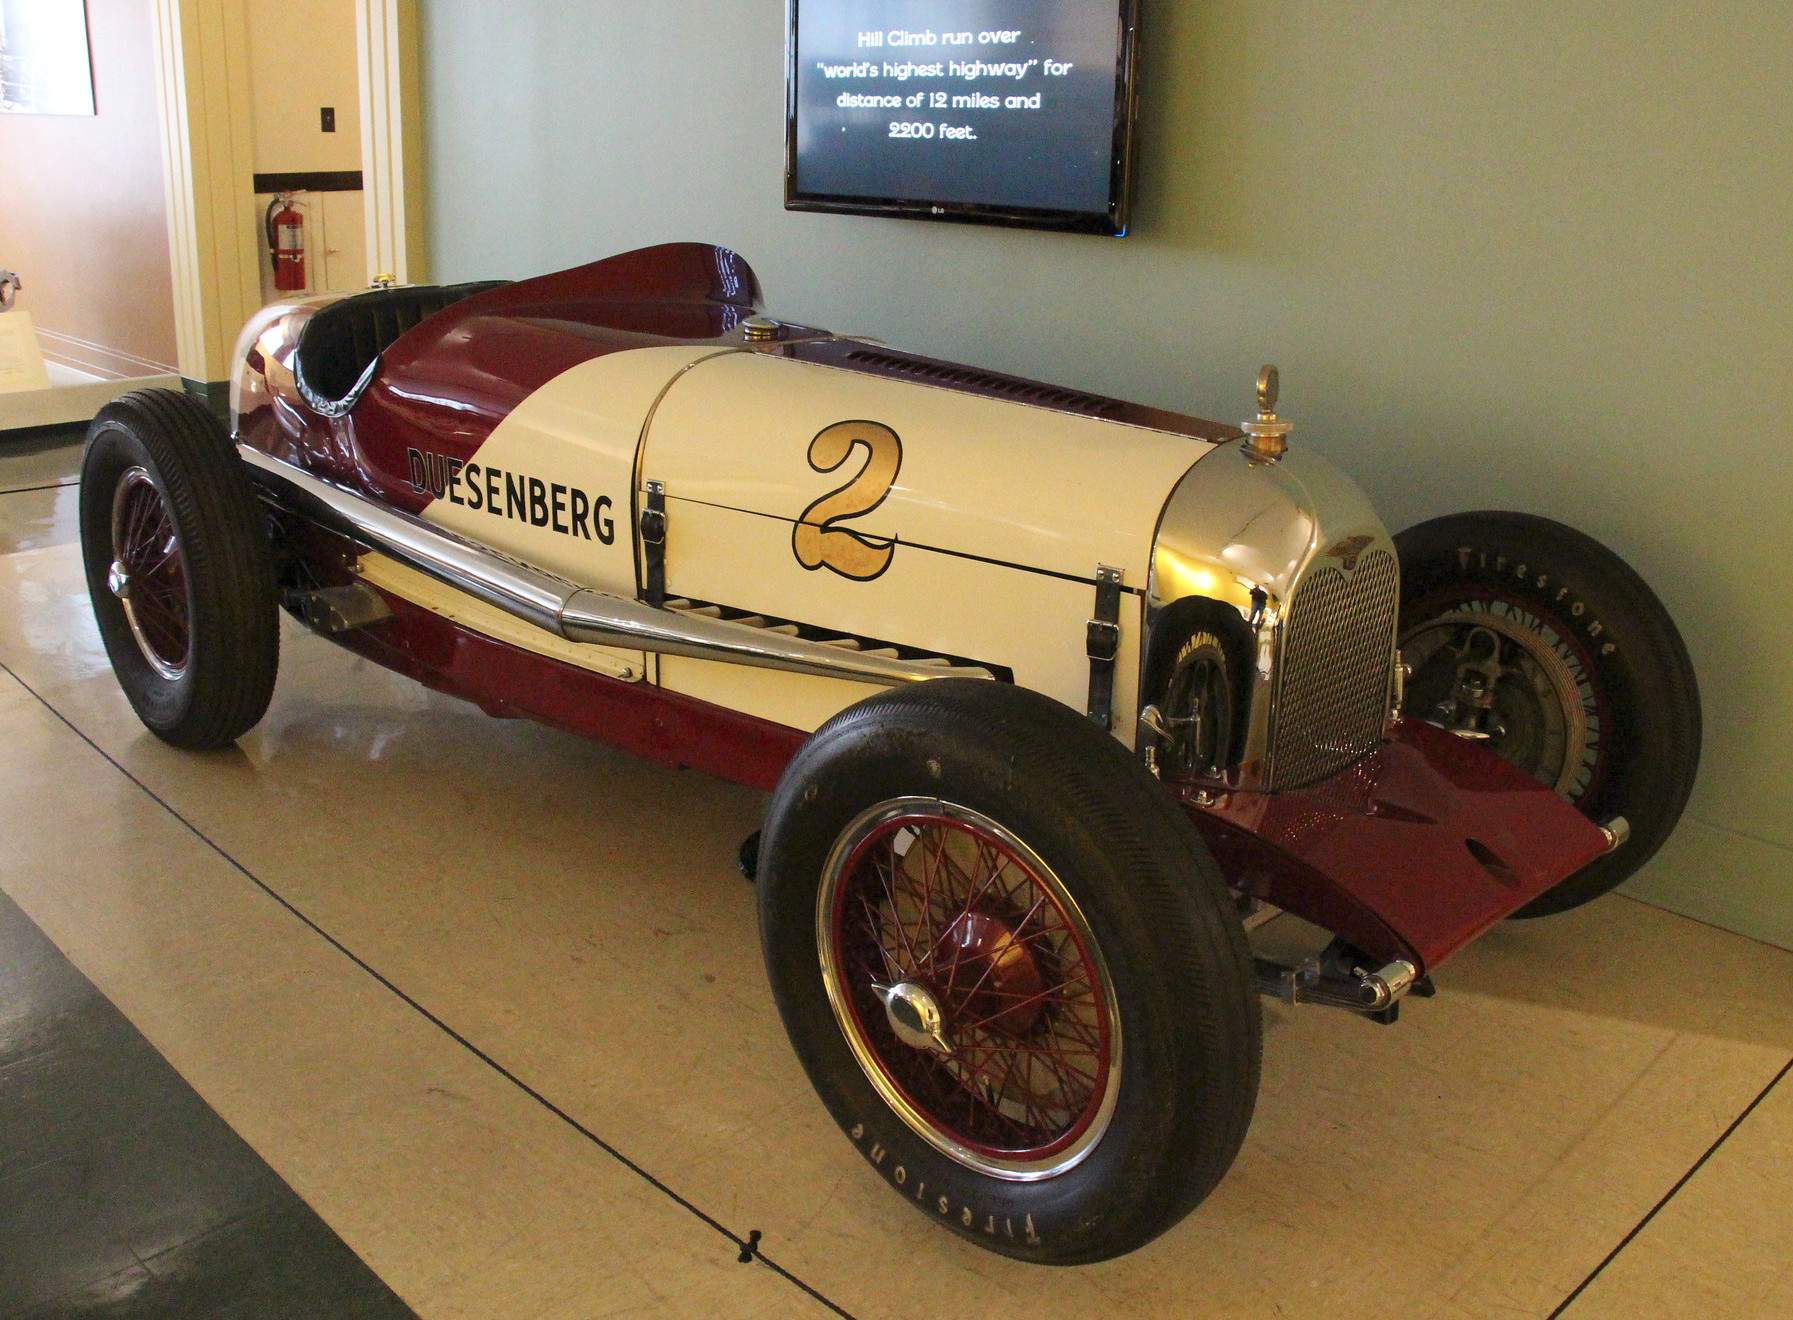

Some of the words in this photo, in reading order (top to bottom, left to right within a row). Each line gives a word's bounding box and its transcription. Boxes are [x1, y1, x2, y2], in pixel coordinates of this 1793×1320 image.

[857, 31, 883, 48] Hill
[887, 29, 937, 46] Climb
[942, 31, 973, 45] run
[978, 30, 1021, 44] over
[883, 61, 944, 81] highest
[948, 58, 1038, 80] highway"
[1043, 58, 1073, 76] for
[836, 92, 902, 108] distance
[905, 91, 925, 108] of
[929, 91, 948, 108] 12
[952, 92, 1000, 109] miles
[1004, 92, 1041, 109] and
[888, 121, 935, 139] 2200
[939, 123, 978, 140] feet.
[407, 447, 615, 546] DUESENBERG
[792, 419, 903, 582] 2
